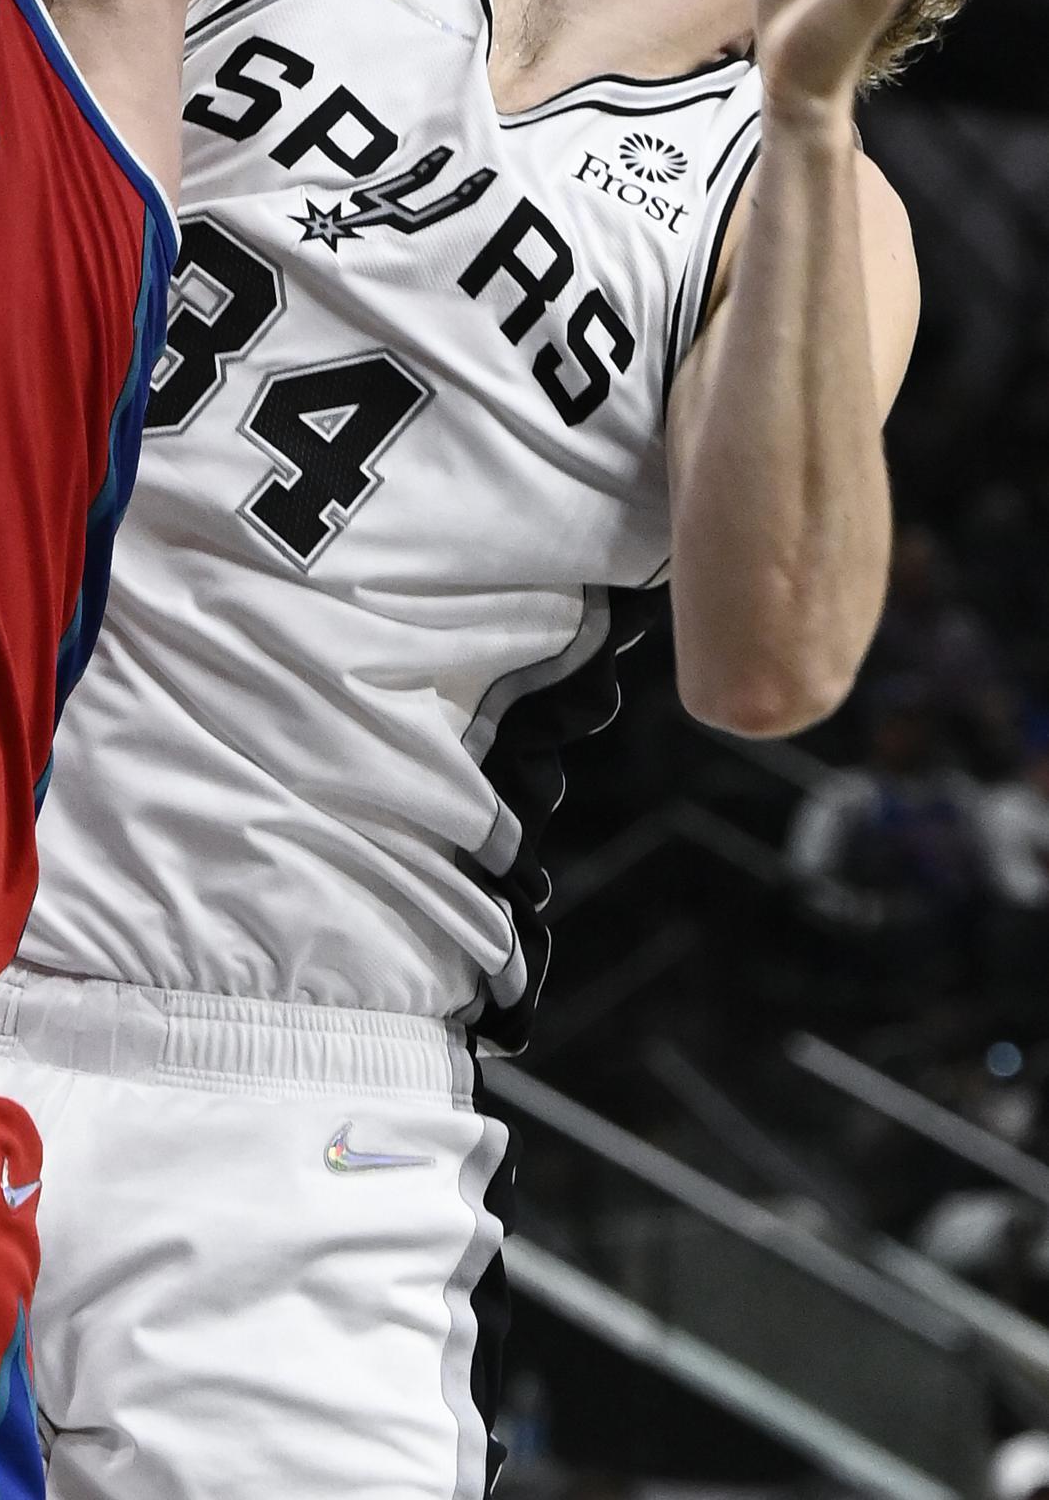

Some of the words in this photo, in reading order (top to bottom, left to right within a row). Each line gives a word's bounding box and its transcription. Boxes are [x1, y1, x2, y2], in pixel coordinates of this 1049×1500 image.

[182, 35, 636, 427] SPURS
[571, 150, 689, 235] Frost
[142, 211, 438, 574] 34
